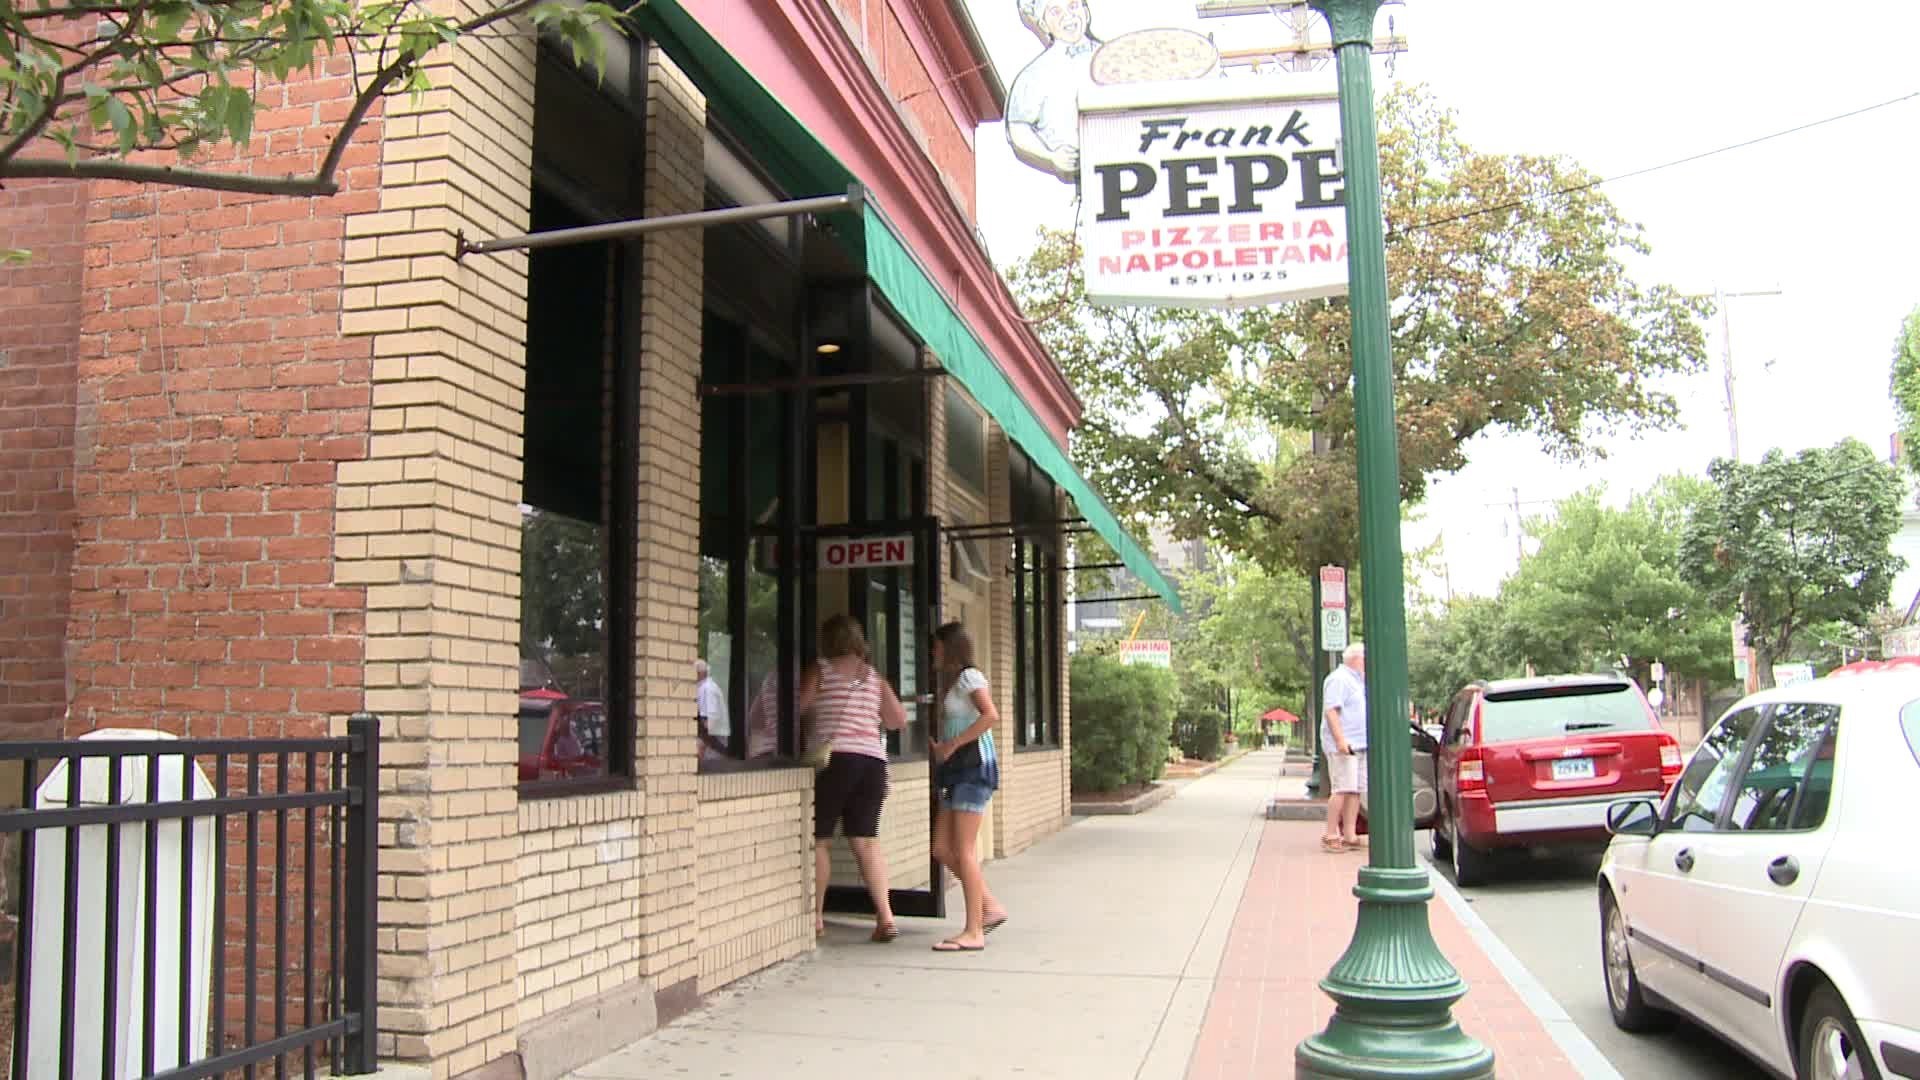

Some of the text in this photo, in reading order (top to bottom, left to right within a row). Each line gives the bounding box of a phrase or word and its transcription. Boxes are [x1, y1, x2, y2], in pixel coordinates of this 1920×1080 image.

[1138, 110, 1313, 153] Frank
[1094, 149, 1345, 222] PEPE
[1122, 219, 1334, 250] PIZZERIA
[1232, 270, 1287, 283] 1925
[827, 541, 905, 565] OPEN
[1120, 641, 1169, 651] PARKING
